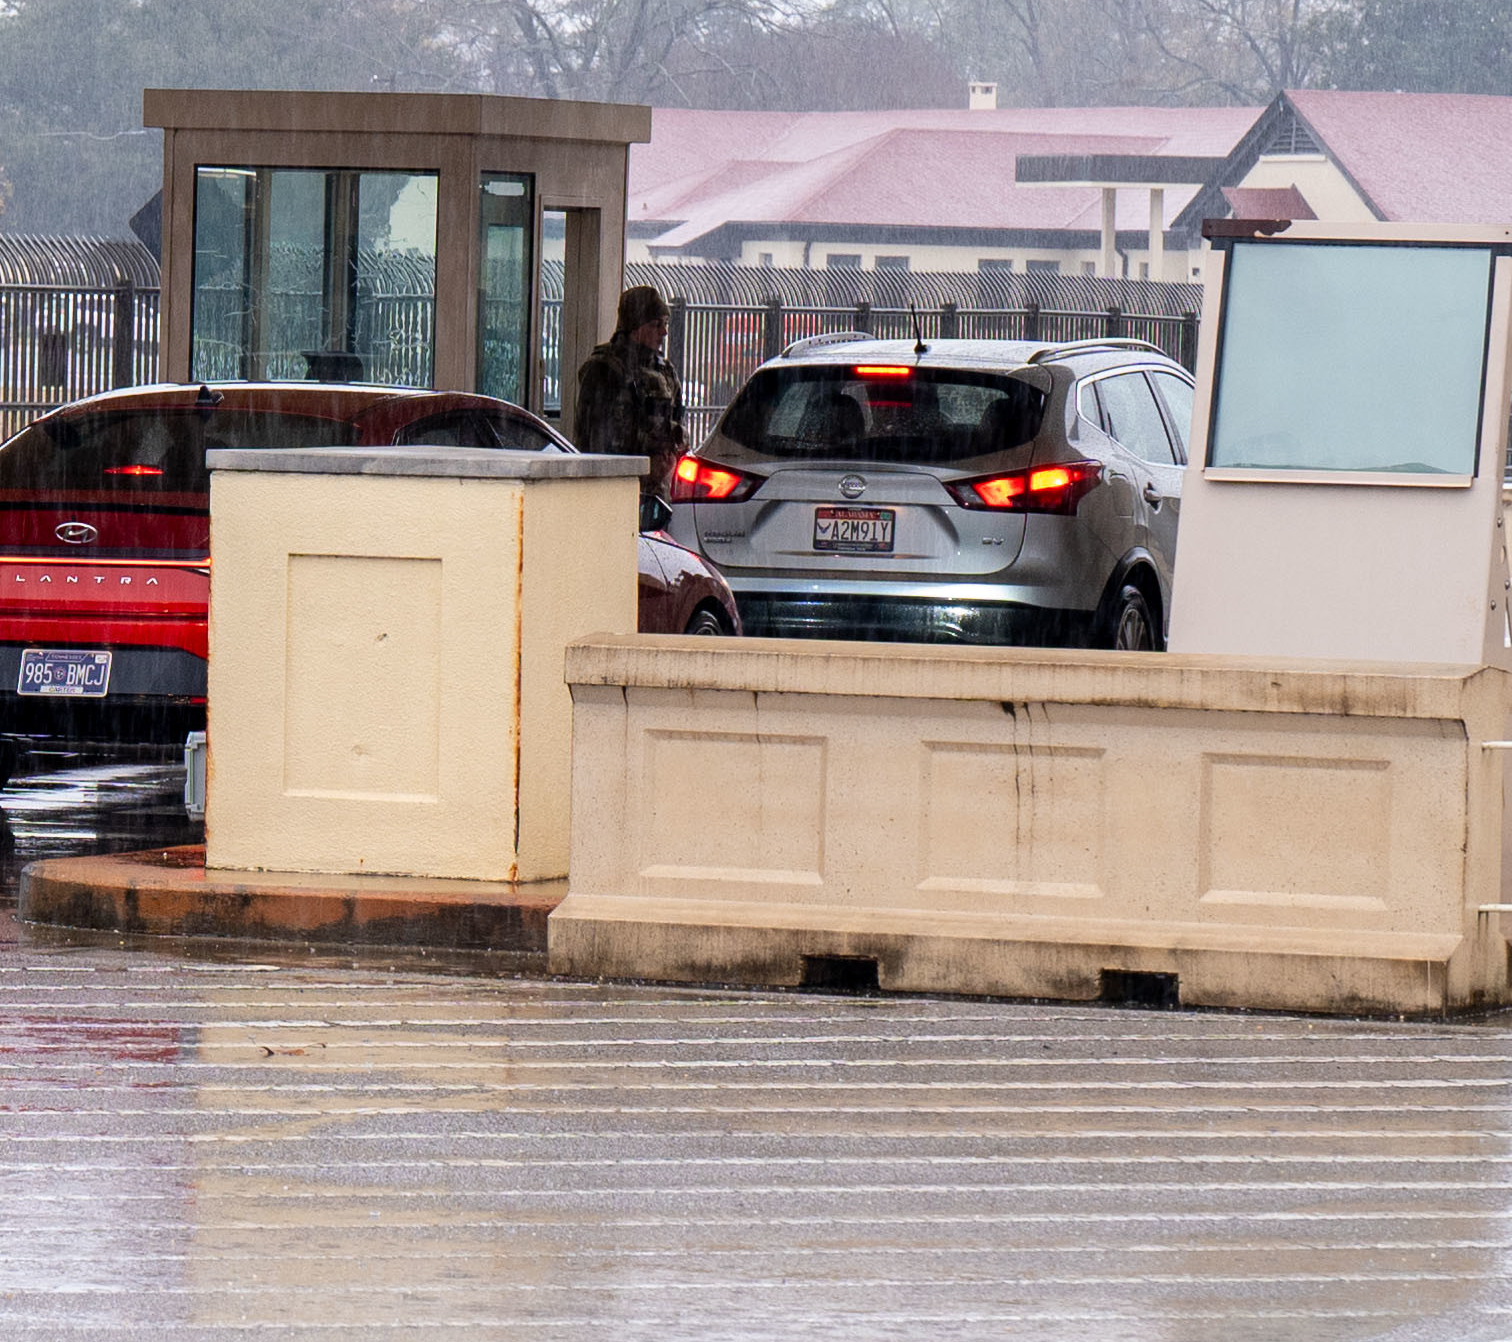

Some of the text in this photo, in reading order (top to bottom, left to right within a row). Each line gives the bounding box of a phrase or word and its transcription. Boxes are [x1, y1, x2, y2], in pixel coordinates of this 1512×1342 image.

[831, 520, 889, 541] A2M91Y
[25, 662, 106, 686] 985 BMCJ
